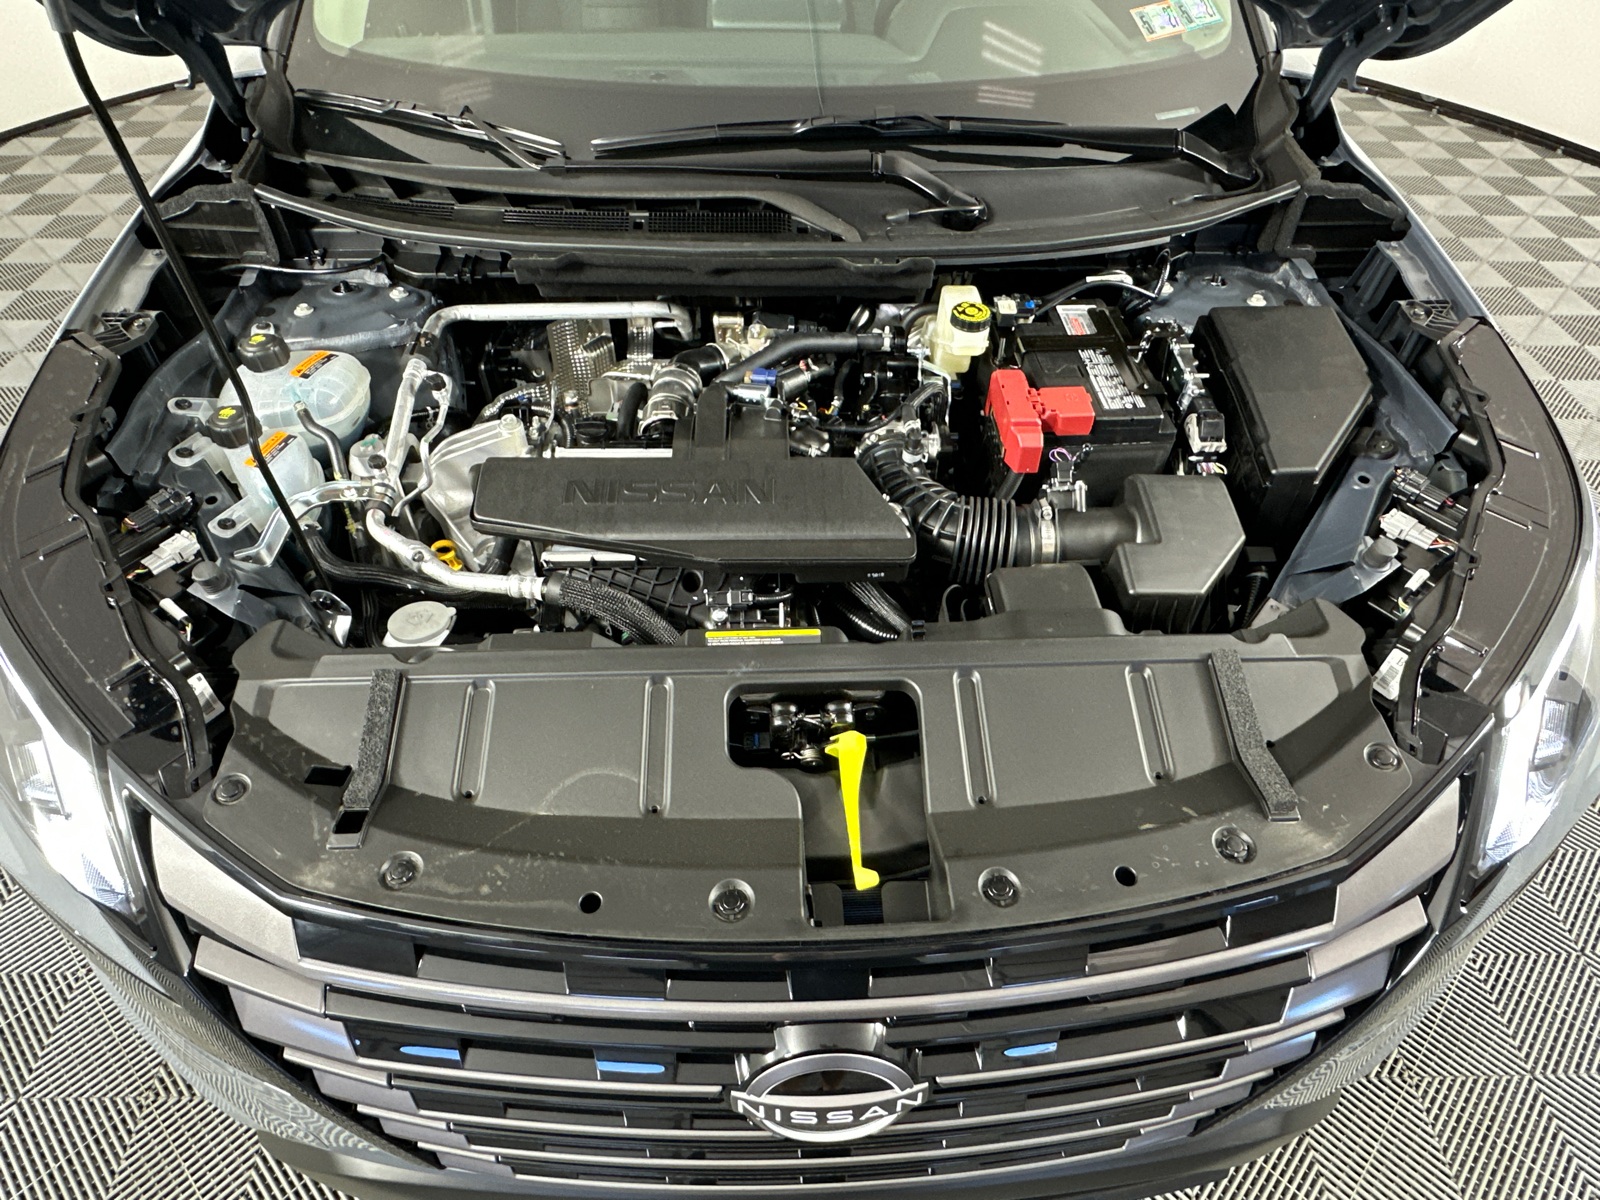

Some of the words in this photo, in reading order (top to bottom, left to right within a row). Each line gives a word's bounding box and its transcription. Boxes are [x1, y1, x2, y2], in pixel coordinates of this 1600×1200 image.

[1139, 15, 1154, 35] 5
[563, 478, 775, 504] NISSAN
[737, 1091, 923, 1125] NISSAN
